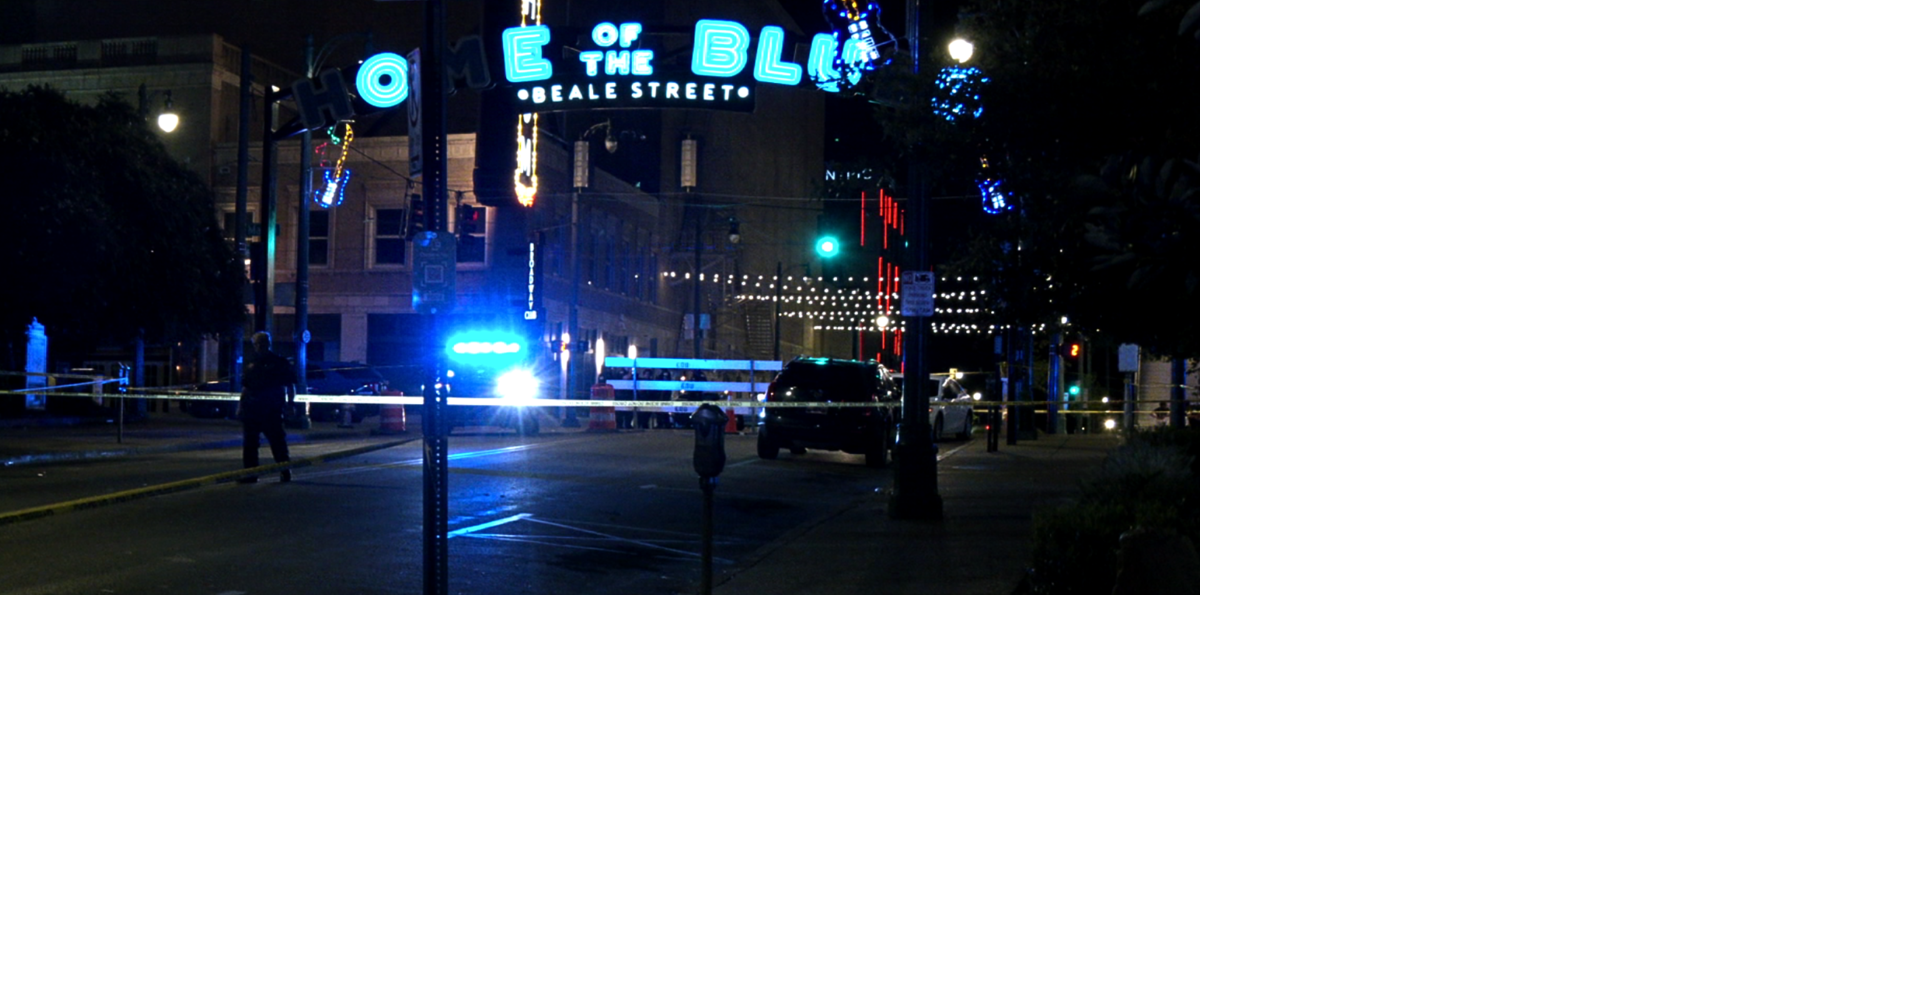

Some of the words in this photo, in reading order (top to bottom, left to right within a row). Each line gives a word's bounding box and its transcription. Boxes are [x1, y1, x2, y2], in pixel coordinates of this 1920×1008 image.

[592, 22, 642, 48] OF
[579, 50, 653, 76] THE
[532, 82, 617, 103] BEALE
[631, 82, 734, 101] STREET
